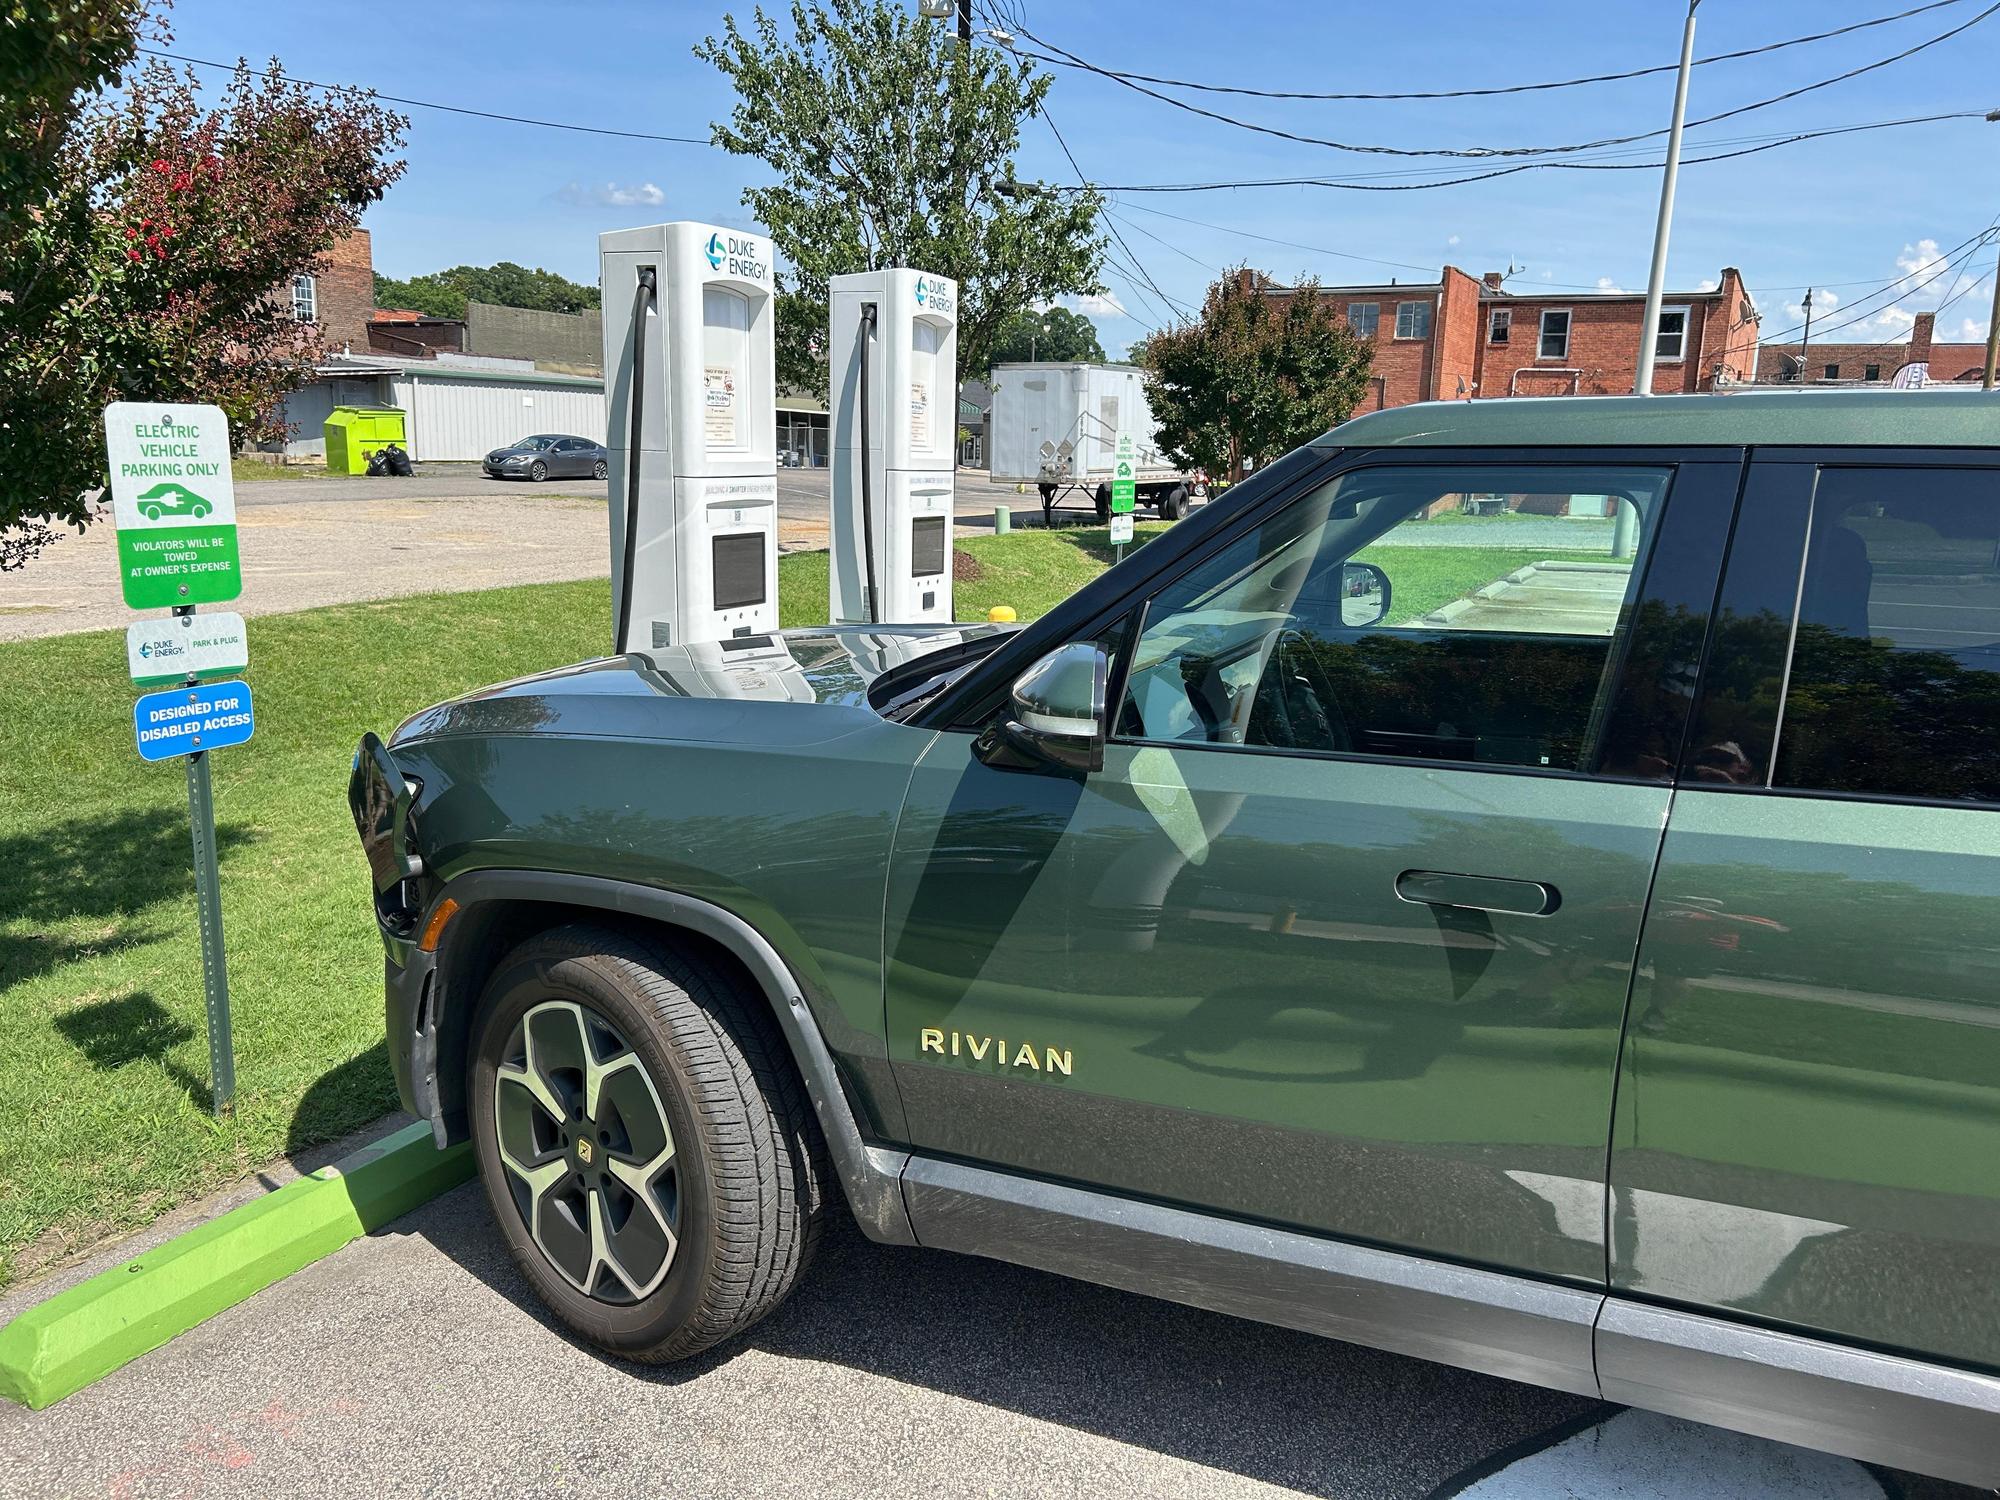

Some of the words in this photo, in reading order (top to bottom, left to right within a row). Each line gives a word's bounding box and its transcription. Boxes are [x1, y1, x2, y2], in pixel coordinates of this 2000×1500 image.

[729, 238, 754, 258] DUKE
[730, 258, 767, 280] ENERGY
[930, 280, 946, 296] DUKE
[930, 296, 953, 313] ENERGY
[135, 425, 200, 438] ELECTRIC
[140, 444, 198, 457] VEHICLE
[122, 463, 181, 477] PARKING
[186, 463, 219, 476] ONLY
[133, 540, 184, 551] VIOLATORS
[187, 539, 209, 548] WILL
[212, 538, 224, 547] BE
[163, 552, 197, 562] TOWED
[131, 568, 142, 577] AT
[144, 564, 188, 576] OWNER'S
[190, 562, 231, 573] EXPENSE
[154, 640, 173, 649] DUKE
[193, 639, 212, 648] PARK
[220, 636, 238, 645] PLUG
[154, 647, 183, 658] ENERGY
[150, 702, 212, 722] DESIGNED
[215, 698, 239, 712] FOR
[140, 721, 200, 742] DISABLED
[203, 713, 250, 731] ACCESS
[921, 1028, 1072, 1076] RIVIAN
